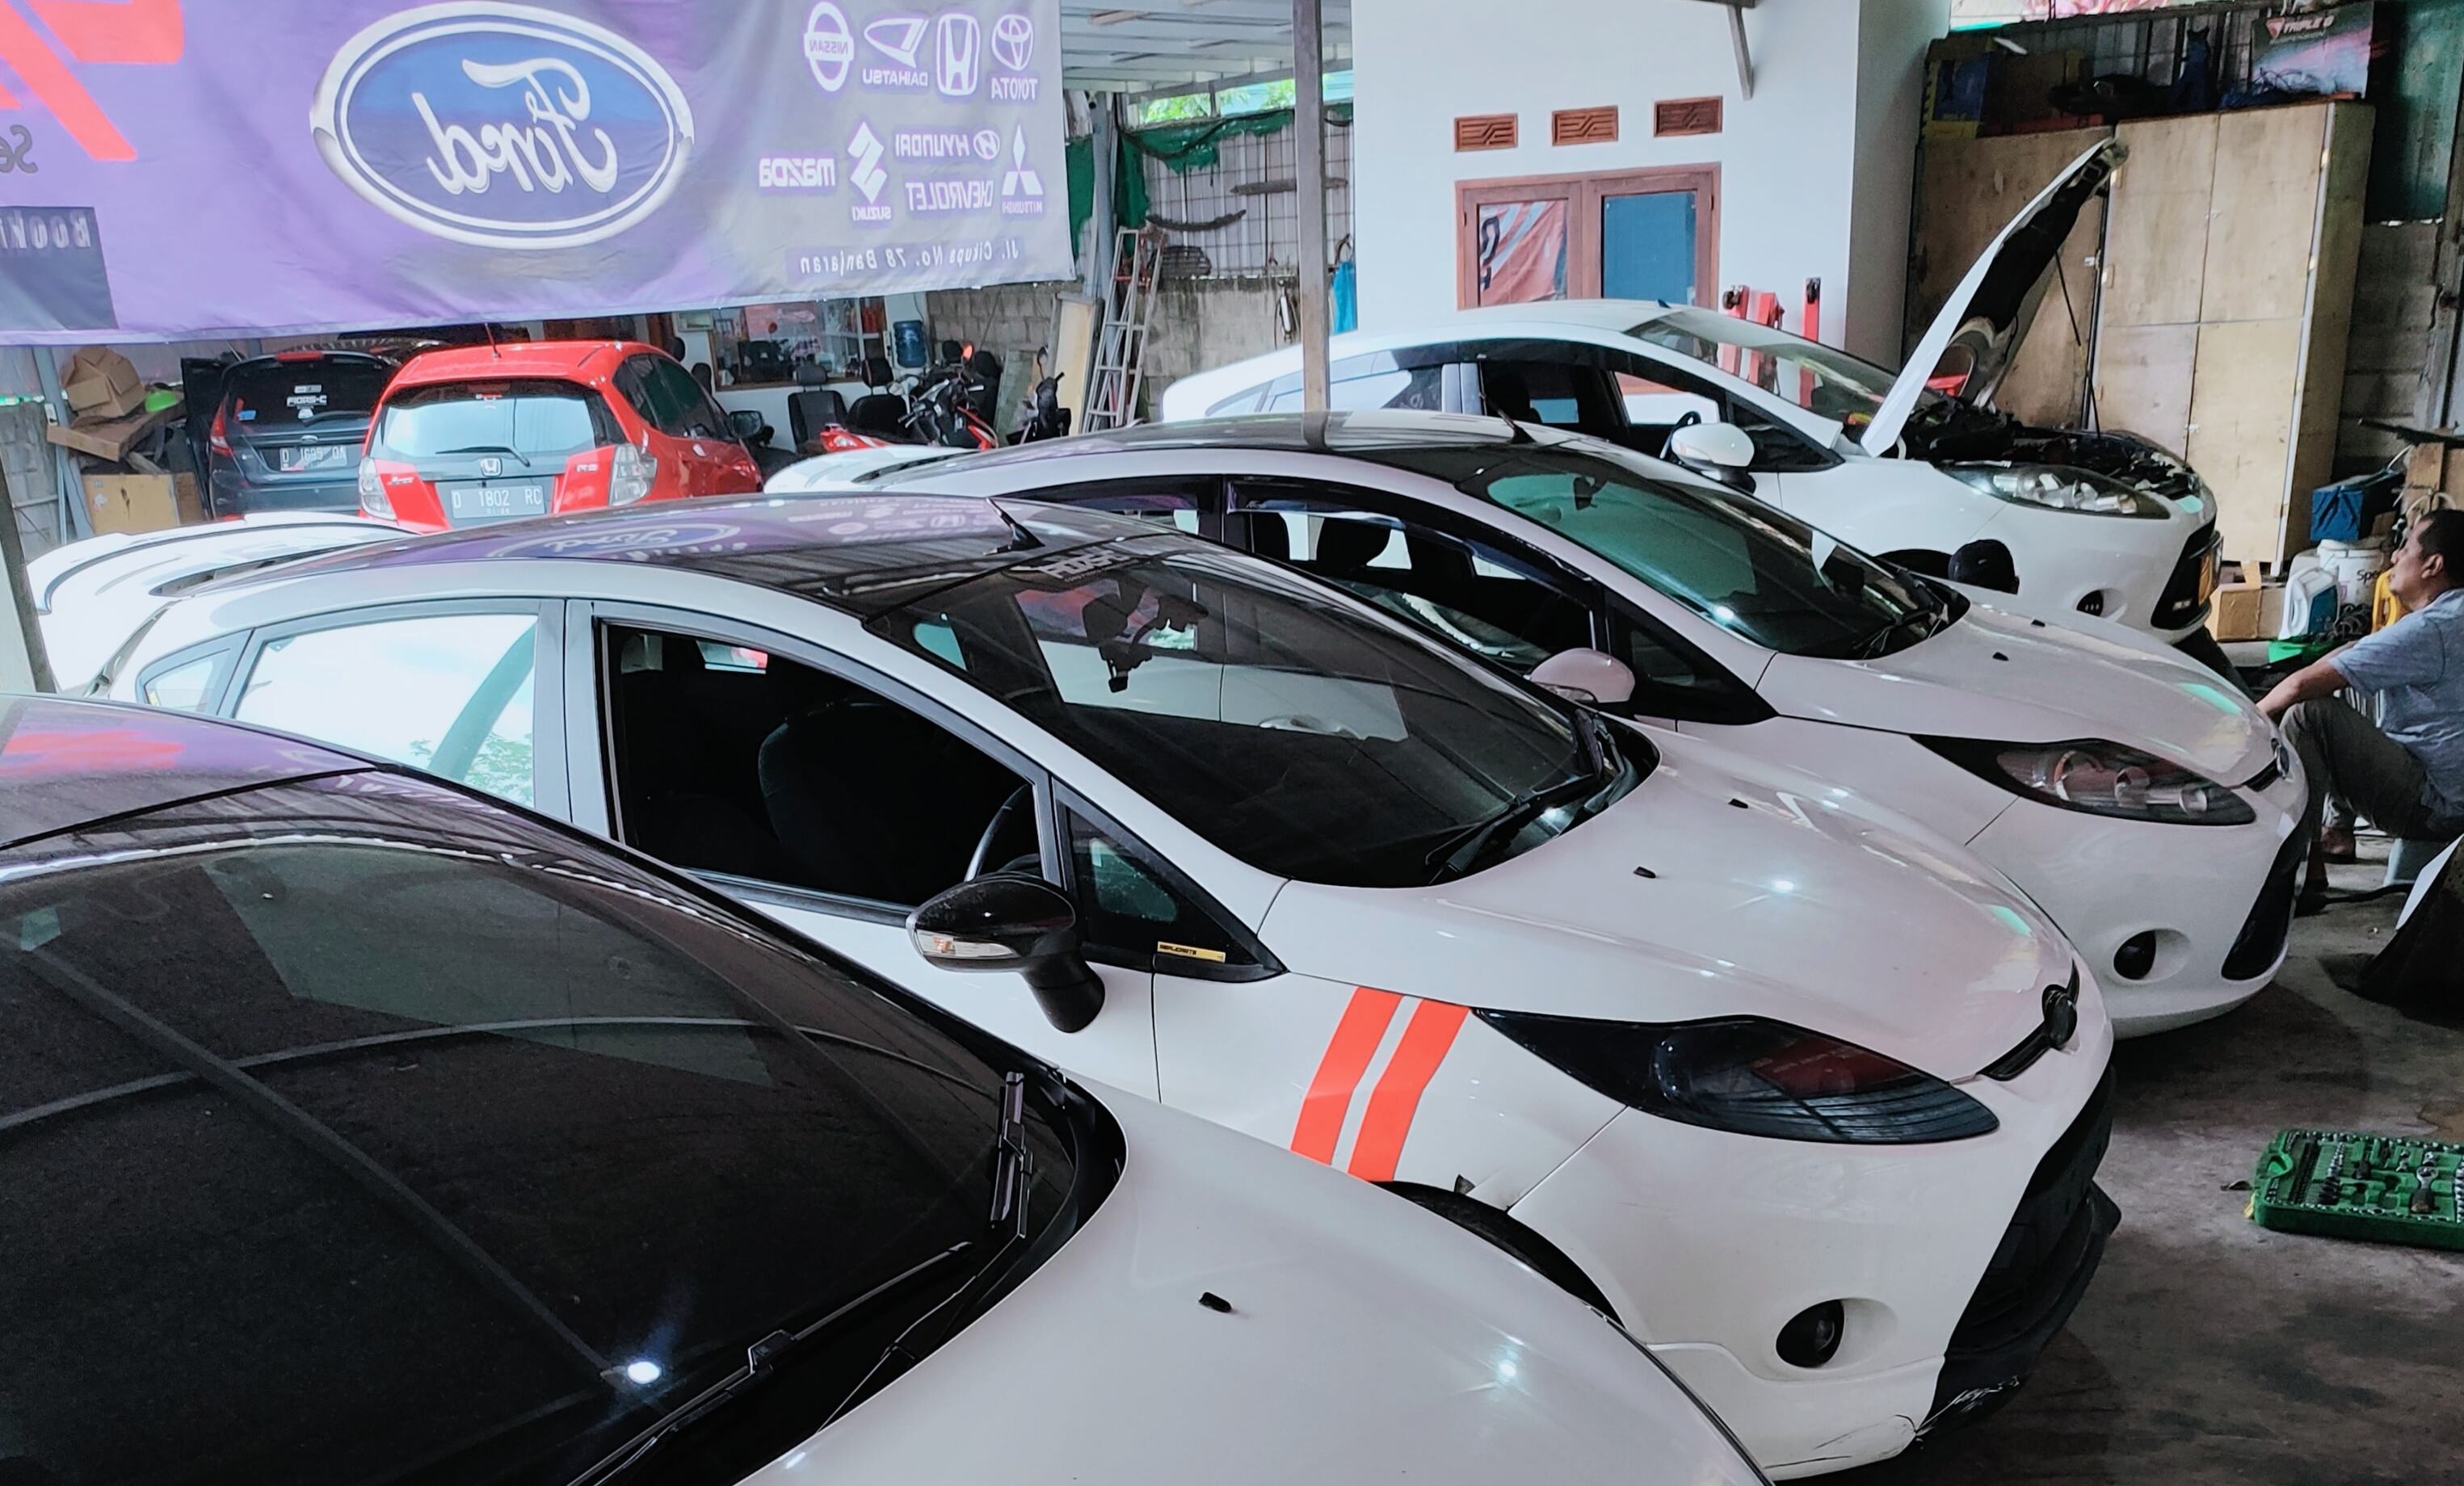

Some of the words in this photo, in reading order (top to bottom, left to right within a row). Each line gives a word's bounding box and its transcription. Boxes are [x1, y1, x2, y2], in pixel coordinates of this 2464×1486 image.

[282, 448, 290, 463] D
[452, 490, 462, 509] D
[478, 489, 511, 507] 1802
[524, 487, 542, 505] RC
